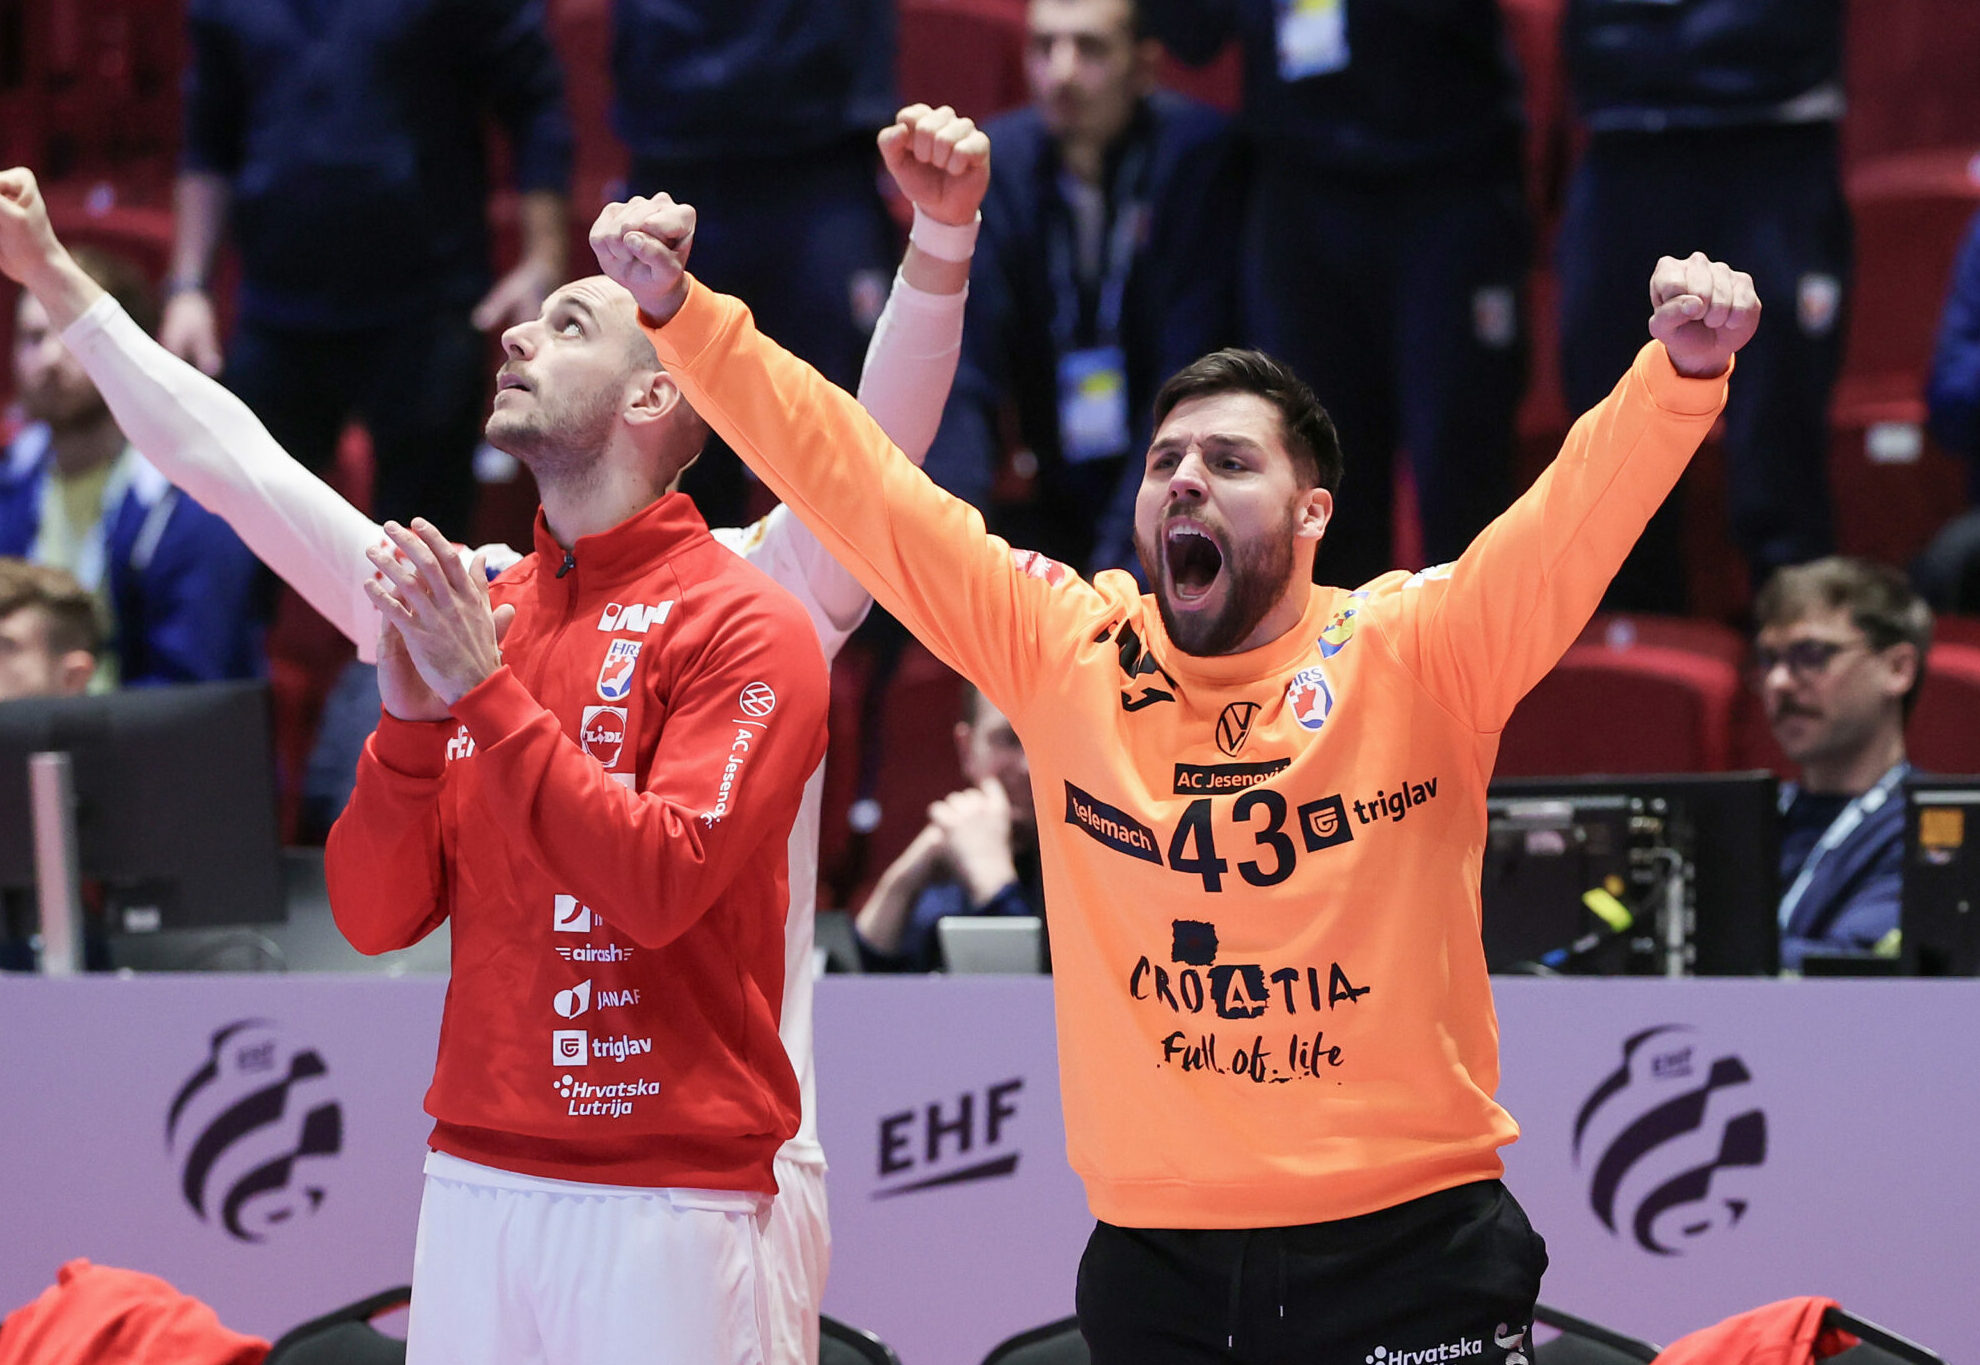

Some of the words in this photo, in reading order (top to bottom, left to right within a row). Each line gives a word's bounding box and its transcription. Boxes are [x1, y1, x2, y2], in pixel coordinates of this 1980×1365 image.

[732, 728, 753, 752] AC
[1176, 771, 1204, 788] AC
[1352, 776, 1438, 825] triglav
[1072, 796, 1153, 852] telemach
[1167, 789, 1297, 893] 43
[597, 988, 641, 1011] JANAF
[1129, 955, 1371, 1019] CROATIA
[591, 1034, 653, 1063] triglav
[1160, 1030, 1224, 1074] Full
[1231, 1035, 1271, 1083] of
[1288, 1031, 1345, 1079] life
[571, 1078, 661, 1099] Hrvatska
[567, 1099, 633, 1119] Lutrija
[878, 1076, 1025, 1178] EHF
[1387, 1336, 1483, 1365] Hrvatska
